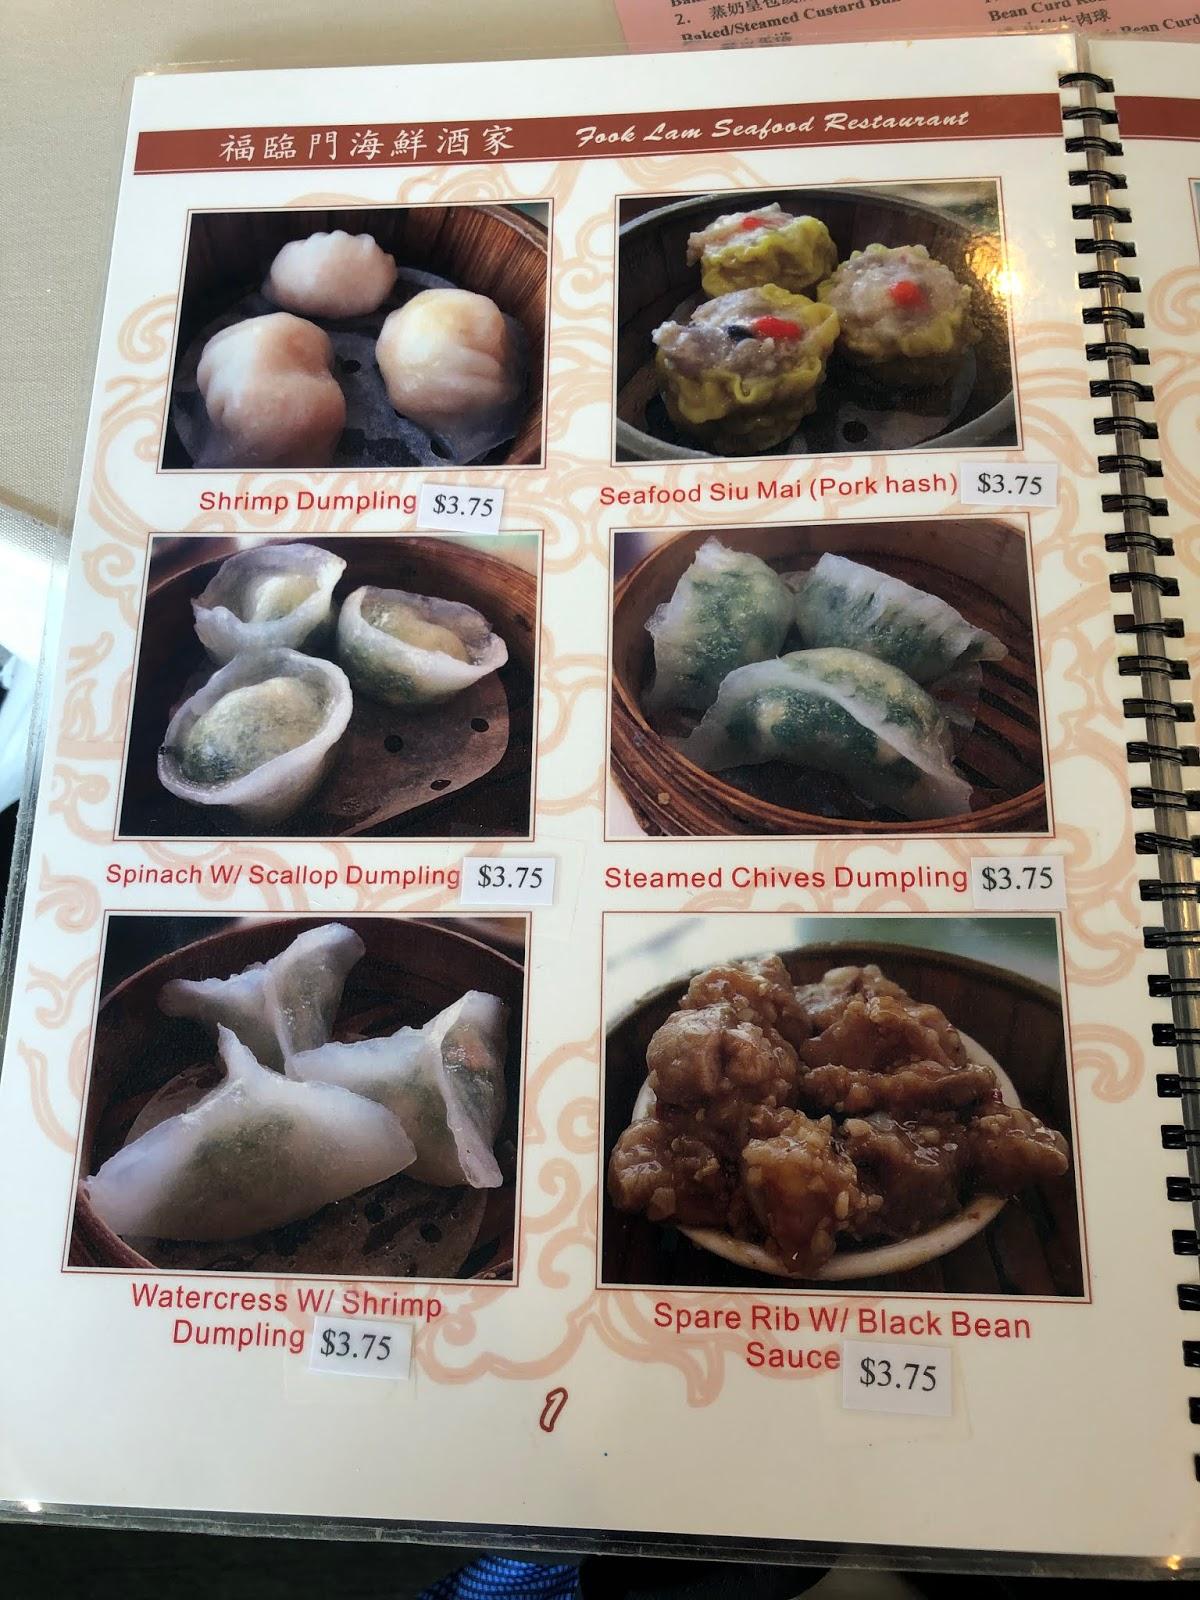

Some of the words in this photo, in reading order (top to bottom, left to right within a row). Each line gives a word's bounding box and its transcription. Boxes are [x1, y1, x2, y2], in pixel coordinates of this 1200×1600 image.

[674, 13, 691, 26] 2.
[681, 11, 800, 41] Baked/Steamed
[803, 0, 865, 20] Custard
[988, 8, 1028, 22] Bean
[1031, 0, 1072, 13] Curd
[1162, 14, 1200, 30] Curd
[220, 124, 515, 162] 福臨門海鮮酒家
[575, 126, 636, 148] Fook
[643, 122, 703, 142] Lam
[711, 117, 815, 140] Seafood
[824, 111, 970, 131] Restaurant
[600, 485, 701, 506] Seafood
[710, 483, 749, 501] Siu
[758, 480, 802, 500] Mai
[810, 477, 878, 502] (Pork
[886, 473, 957, 495] hash)
[977, 473, 1043, 496] $3.75
[200, 491, 289, 514] Shrimp
[297, 491, 417, 515] Dumpling
[432, 494, 494, 517] $3.75
[106, 864, 202, 889] Spinach
[210, 865, 243, 884] W/
[249, 865, 338, 888] Scallop
[346, 865, 460, 891] Dumpling
[477, 865, 543, 890] $3.75
[605, 868, 722, 889] Steamed
[731, 867, 826, 888] Chives
[835, 866, 968, 893] Dumpling
[982, 866, 1054, 892] $3.75
[132, 1283, 288, 1312] Watercress
[298, 1288, 335, 1313] W/
[342, 1290, 442, 1322] Shrimp
[654, 1302, 742, 1334] Spare
[751, 1305, 800, 1331] Rib
[809, 1307, 849, 1333] W/
[859, 1309, 942, 1336] Black
[953, 1311, 1032, 1339] Bean
[173, 1319, 305, 1353] Dumpling
[320, 1329, 391, 1361] $3.75
[746, 1342, 841, 1369] Sauce
[859, 1357, 937, 1391] $3.75
